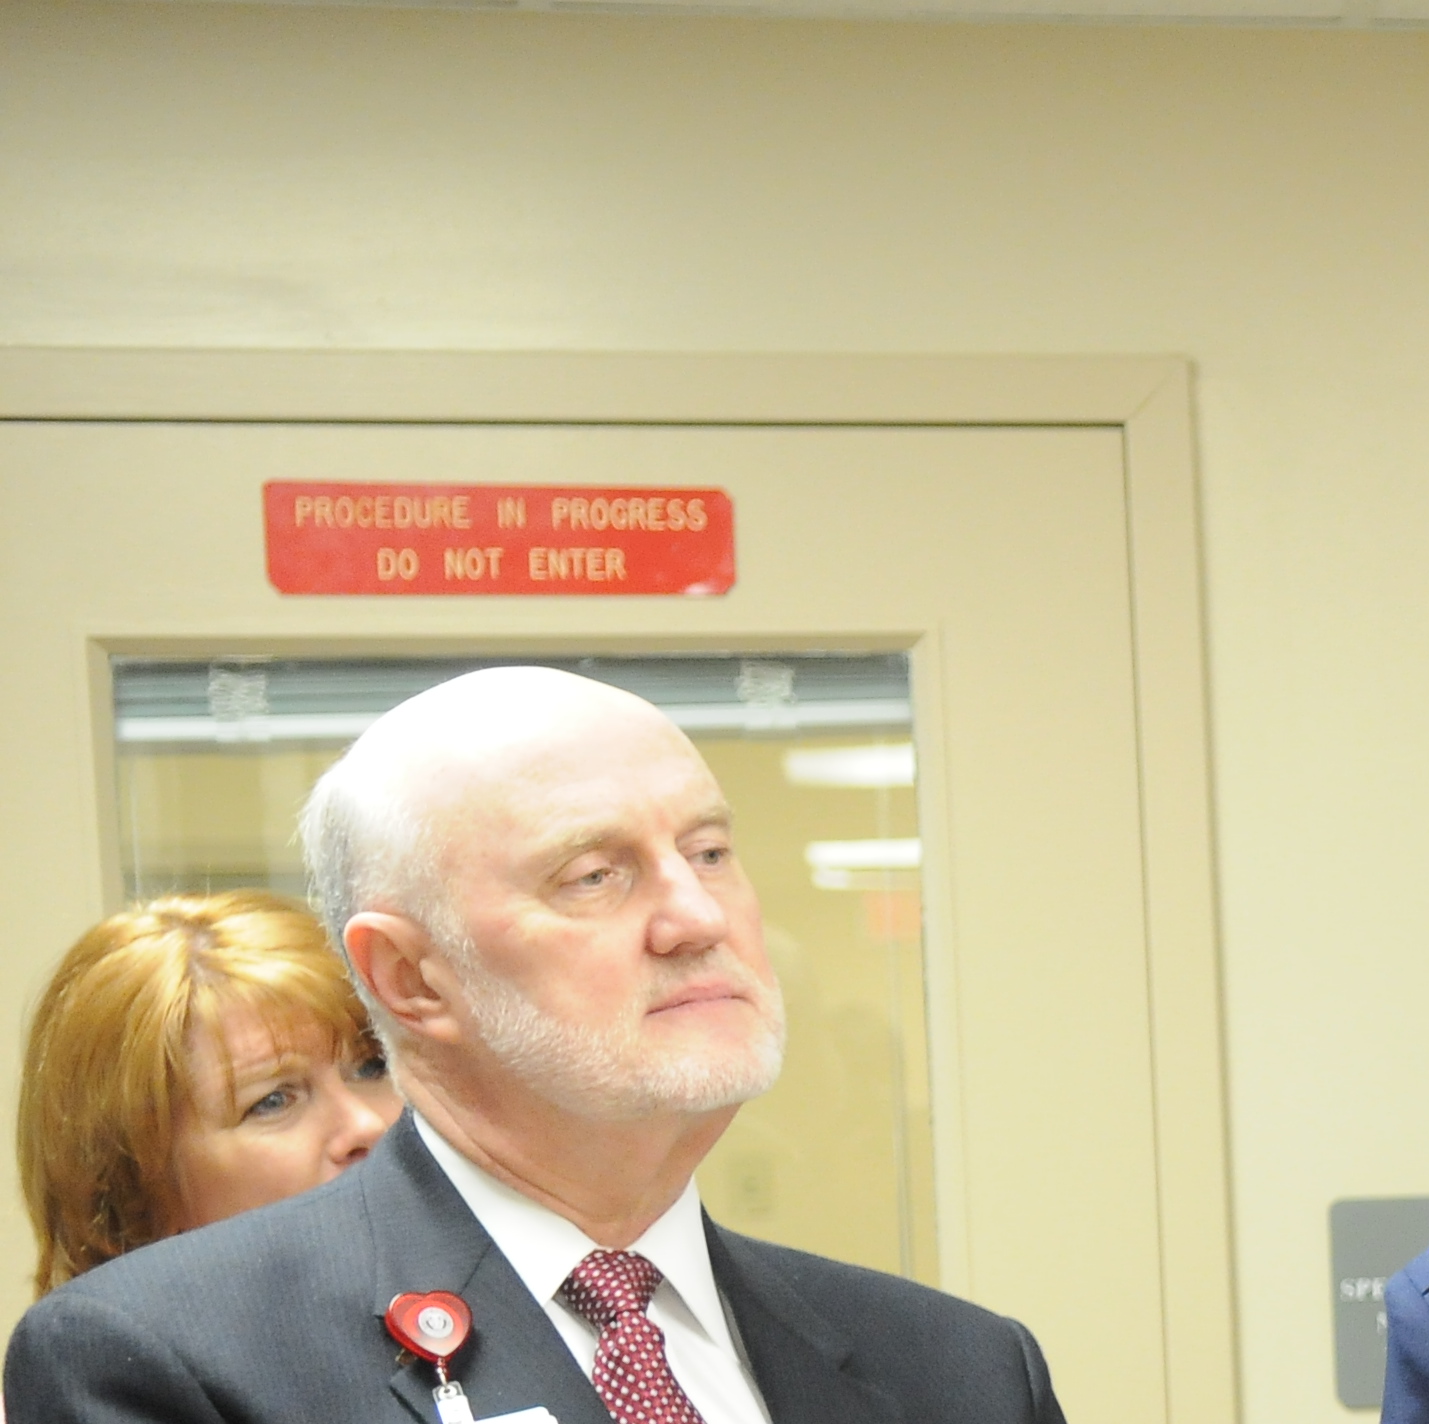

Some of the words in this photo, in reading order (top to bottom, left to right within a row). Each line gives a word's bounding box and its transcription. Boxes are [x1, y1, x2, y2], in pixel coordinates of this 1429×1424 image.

[294, 495, 472, 529] PROCEDURE
[497, 496, 526, 529] IN
[551, 497, 708, 532] PROGRESS
[376, 547, 420, 580] DO
[444, 547, 504, 580] NOT
[528, 547, 626, 581] ENTER
